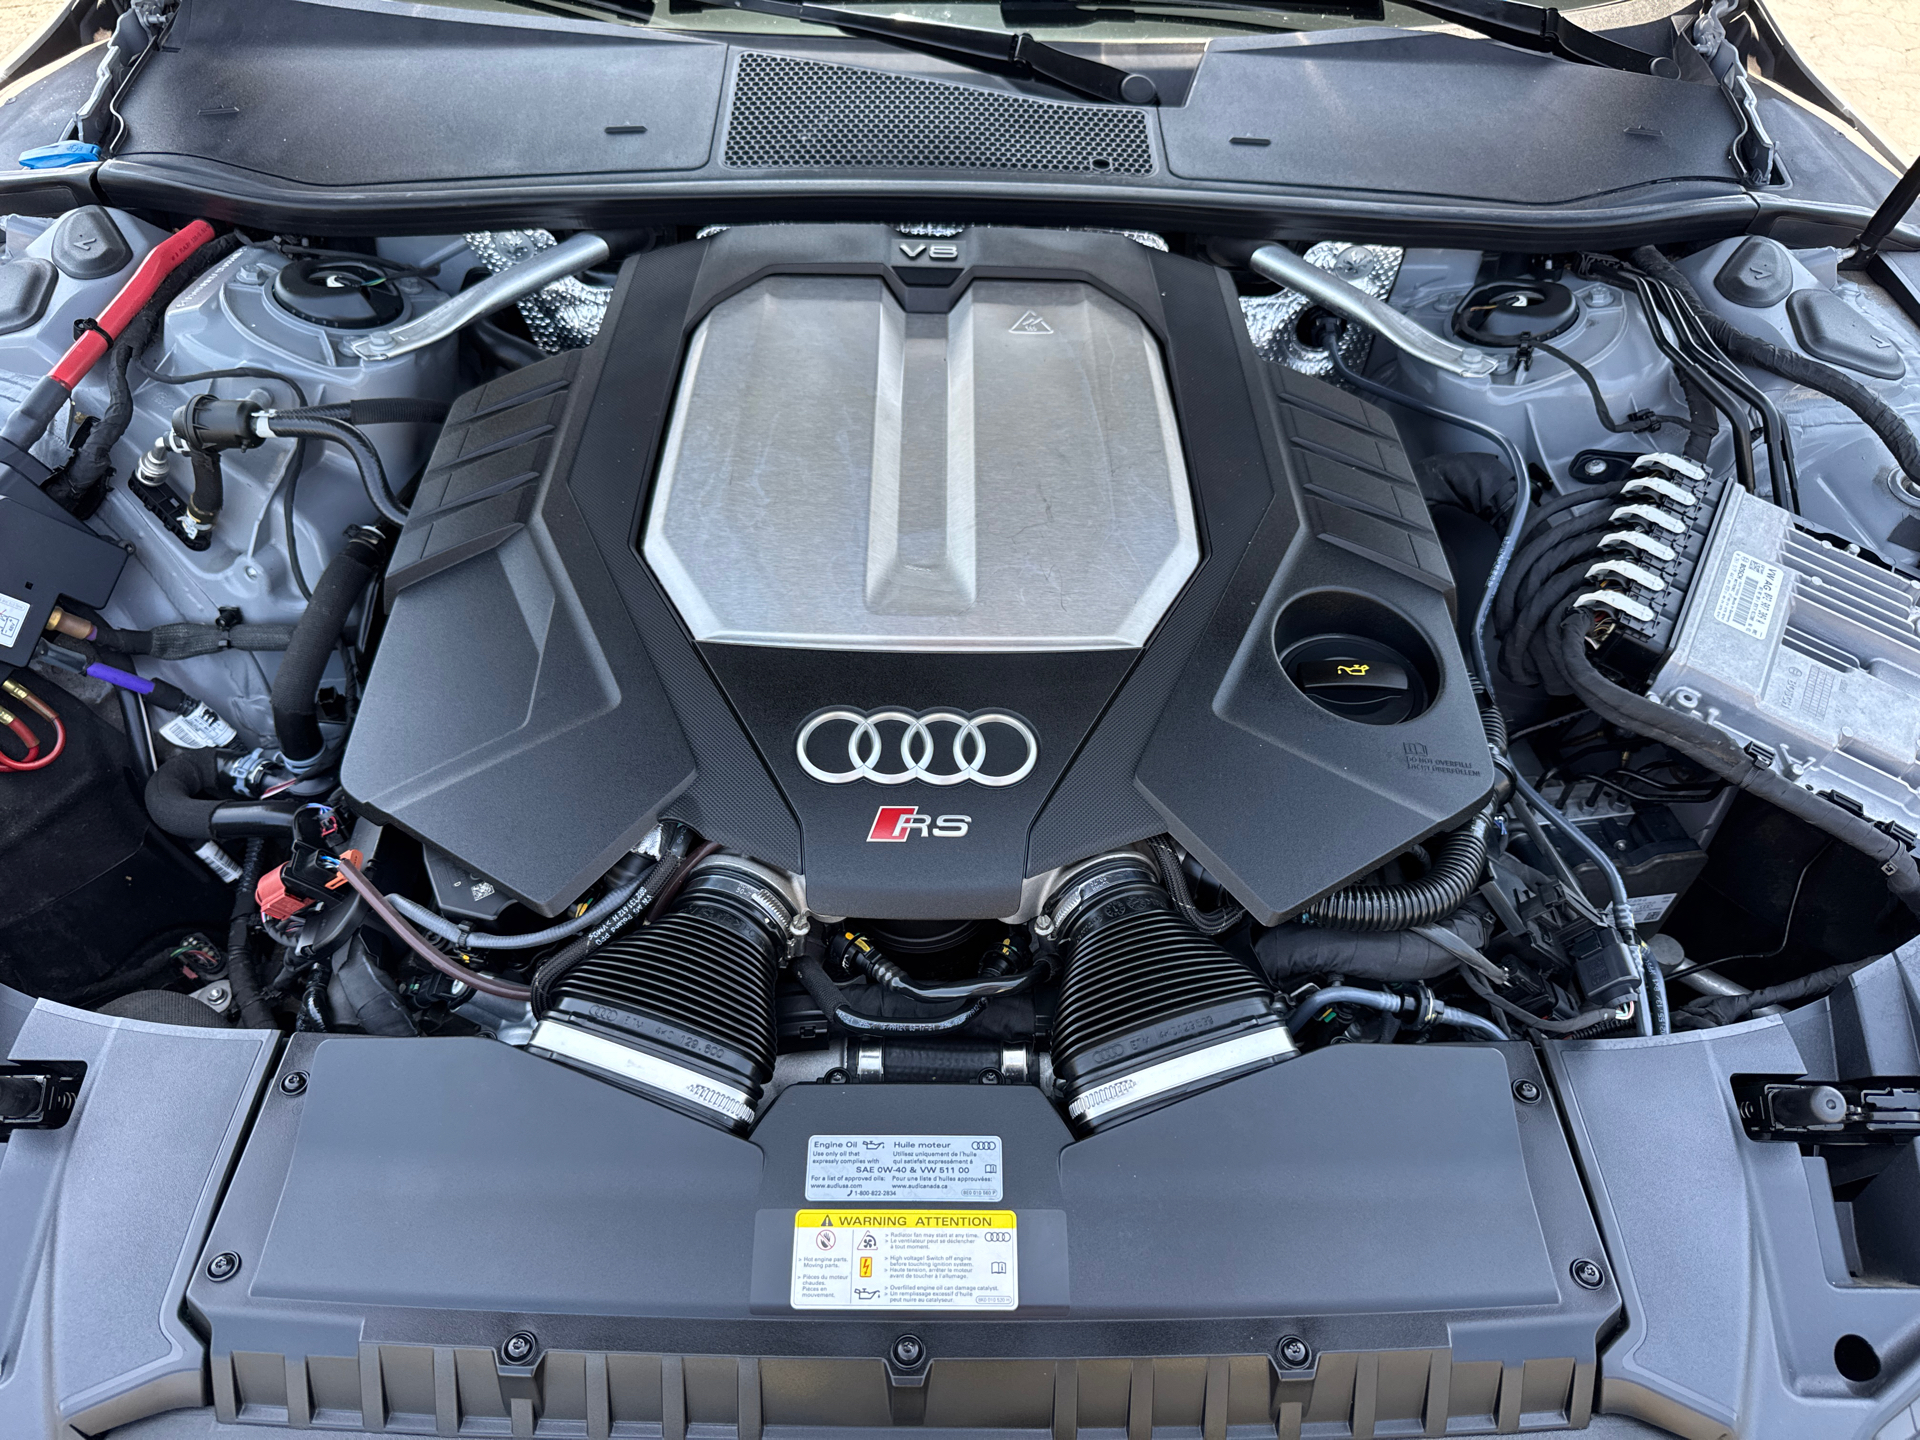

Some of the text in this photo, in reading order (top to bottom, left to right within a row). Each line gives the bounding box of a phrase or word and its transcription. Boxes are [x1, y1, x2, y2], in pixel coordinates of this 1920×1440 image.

[899, 243, 958, 260] V8
[892, 814, 972, 838] RS
[814, 1141, 843, 1149] Engine
[839, 1216, 992, 1227] WARNING ATTENTION
